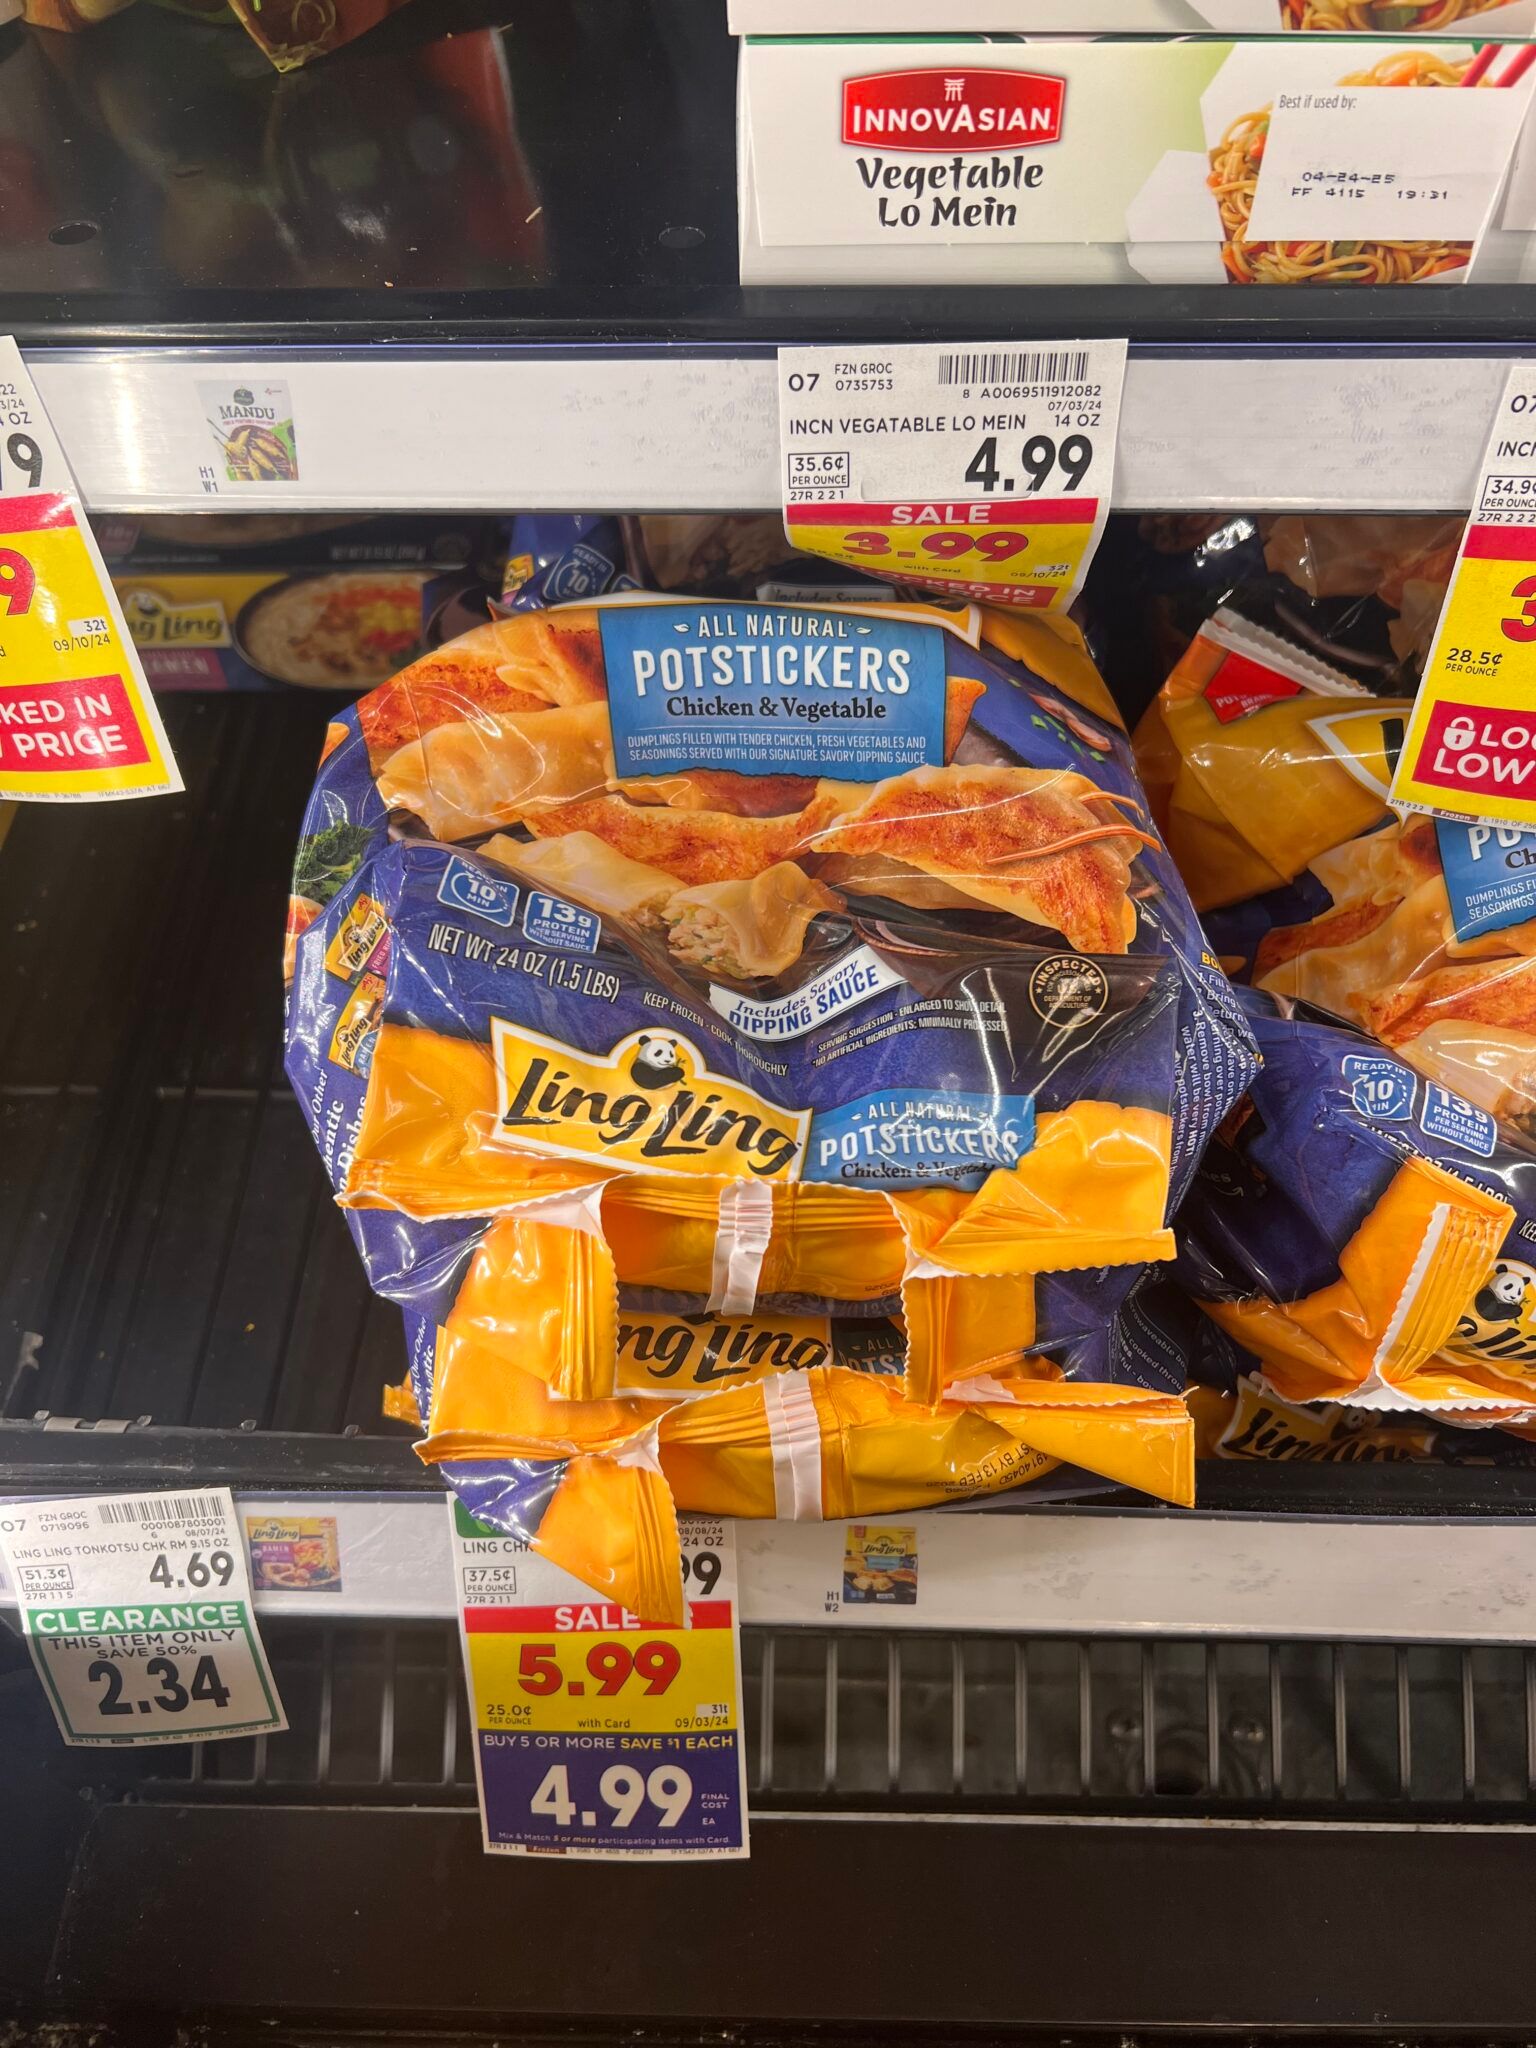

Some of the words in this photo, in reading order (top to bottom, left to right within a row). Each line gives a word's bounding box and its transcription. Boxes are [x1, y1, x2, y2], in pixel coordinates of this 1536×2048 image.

[1279, 95, 1301, 109] Best
[1303, 95, 1313, 109] if
[1314, 95, 1338, 109] used
[1341, 95, 1358, 111] by:
[856, 155, 1044, 199] Vegetable
[1302, 171, 1396, 185] 04-24-25
[1291, 187, 1313, 197] FF
[1325, 187, 1365, 199] 4115
[1397, 190, 1449, 200] 19:31
[878, 197, 920, 227] Lo
[930, 196, 1017, 227] Mein
[834, 364, 857, 376] FZN
[860, 362, 893, 375] GROC
[788, 373, 820, 392] 07
[835, 379, 893, 391] 0735753
[219, 406, 275, 420] MANDU
[1048, 400, 1102, 412] 07/03/24
[9, 411, 32, 424] OZ
[790, 420, 833, 435] INCN
[840, 416, 946, 433] VEGATABLE
[953, 415, 976, 431] LO
[982, 414, 1026, 430] MEIN
[1054, 415, 1070, 428] 14
[1077, 414, 1101, 427] OZ
[795, 456, 845, 472] 35.6¢
[965, 434, 1093, 492] 4.99
[792, 475, 811, 486] PER
[813, 474, 847, 485] OUNCE
[891, 505, 991, 525] SALE
[843, 532, 1029, 562] 3.99
[85, 619, 108, 632] 32t
[698, 615, 737, 638] ALL
[53, 633, 111, 652] 09/10/24
[1447, 648, 1503, 667] 28.5¢
[632, 645, 911, 697] POTSTICKERS
[1466, 666, 1498, 677] OUNCE
[75, 692, 112, 719] IN
[666, 696, 754, 718] Chicken
[759, 698, 779, 717] &
[781, 697, 886, 723] Vegetable
[13, 724, 128, 759] PRICE
[628, 733, 681, 748] DUMPLINGS
[683, 732, 711, 746] FILLED
[713, 732, 737, 746] WITH
[739, 733, 772, 746] TENDER
[774, 734, 815, 749] CHICKEN,
[817, 735, 845, 747] FRESH
[847, 736, 905, 748] VEGETABLES
[906, 736, 926, 749] AND
[630, 747, 687, 761] SEASONINGS
[689, 747, 723, 760] SERVED
[724, 747, 747, 760] WITH
[749, 748, 767, 760] OUR
[769, 749, 818, 761] SIGNATURE
[820, 749, 854, 762] SAVORY
[856, 750, 894, 763] DIPPING
[1434, 747, 1534, 785] LOW
[1440, 810, 1471, 821] Frozen
[1465, 881, 1526, 908] DUMPLINGS
[538, 898, 592, 928] 13g
[533, 918, 591, 939] PROTEIN
[428, 923, 465, 956] NET
[465, 932, 496, 965] WT
[498, 947, 517, 969] 24
[523, 951, 545, 978] OZ
[1035, 959, 1102, 987] INSPECTED
[735, 991, 807, 1018] Includes
[809, 957, 859, 1002] Savory
[1209, 976, 1225, 990] Fill
[729, 1008, 813, 1035] DIPPING
[818, 964, 880, 1016] SAUCE
[818, 1033, 848, 1053] SERVING
[849, 1012, 894, 1040] SUGGESTION
[899, 999, 942, 1017] ENLARGED
[943, 998, 954, 1010] TO
[918, 1017, 962, 1029] MINIMALLY
[643, 991, 669, 1010] KEEP
[670, 1002, 705, 1028] FROZEN
[711, 1024, 734, 1046] COOK
[734, 1040, 789, 1078] THOROUGHLY
[1196, 1021, 1210, 1071] Remove
[1354, 1061, 1393, 1071] READY
[312, 1068, 328, 1114] Other
[1364, 1079, 1394, 1102] 10
[868, 1102, 899, 1120] ALL
[1435, 1087, 1488, 1124] 13g
[502, 1058, 652, 1146] Ling
[640, 1090, 801, 1176] Ling
[1433, 1105, 1489, 1135] PROTEIN
[1427, 1121, 1464, 1141] WITHOUT
[1451, 1120, 1485, 1141] SERVING
[820, 1123, 1020, 1167] POTSTICKERS
[841, 1162, 914, 1181] Chicken
[1129, 1338, 1160, 1369] cooked
[38, 1513, 60, 1522] FZN
[61, 1511, 87, 1521] GROC
[141, 1518, 226, 1531] 0001087803001
[41, 1522, 90, 1532] 0719096
[185, 1528, 225, 1537] 08/07/24
[13, 1550, 41, 1559] LING
[45, 1548, 72, 1558] LING
[76, 1542, 140, 1555] TONKOTSU
[142, 1541, 166, 1551] CHK
[170, 1540, 187, 1550] RM
[190, 1538, 211, 1549] 9.15
[214, 1538, 230, 1548] OZ
[463, 1541, 498, 1554] LING
[704, 1536, 724, 1547] OZ
[25, 1568, 67, 1581] 51.3¢
[150, 1550, 235, 1589] 4.69
[469, 1569, 512, 1583] 37.5¢
[43, 1581, 72, 1590] OUNCE
[467, 1584, 483, 1592] PER
[485, 1583, 515, 1592] OUNCE
[35, 1604, 243, 1634] CLEARANCE
[555, 1606, 641, 1631] SALE
[48, 1635, 102, 1650] THIS
[109, 1633, 163, 1647] ITEM
[173, 1629, 236, 1645] ONLY
[97, 1647, 149, 1660] SAVE
[156, 1645, 198, 1656] 50%
[517, 1640, 682, 1697] 5.99
[88, 1655, 231, 1716] 2.34
[486, 1704, 533, 1717] 25.0¢
[489, 1717, 503, 1725] PER
[506, 1717, 532, 1726] OUNCE
[577, 1718, 601, 1729] with
[605, 1718, 631, 1729] Card
[675, 1716, 729, 1729] 09/03/24
[484, 1735, 517, 1748] BUY
[521, 1735, 530, 1748] 5
[536, 1736, 561, 1748] OR
[566, 1737, 615, 1749] MORE
[621, 1738, 662, 1750] SAVE
[686, 1735, 733, 1749] EACH
[530, 1764, 693, 1828] 4.99
[701, 1793, 730, 1801] FINAL
